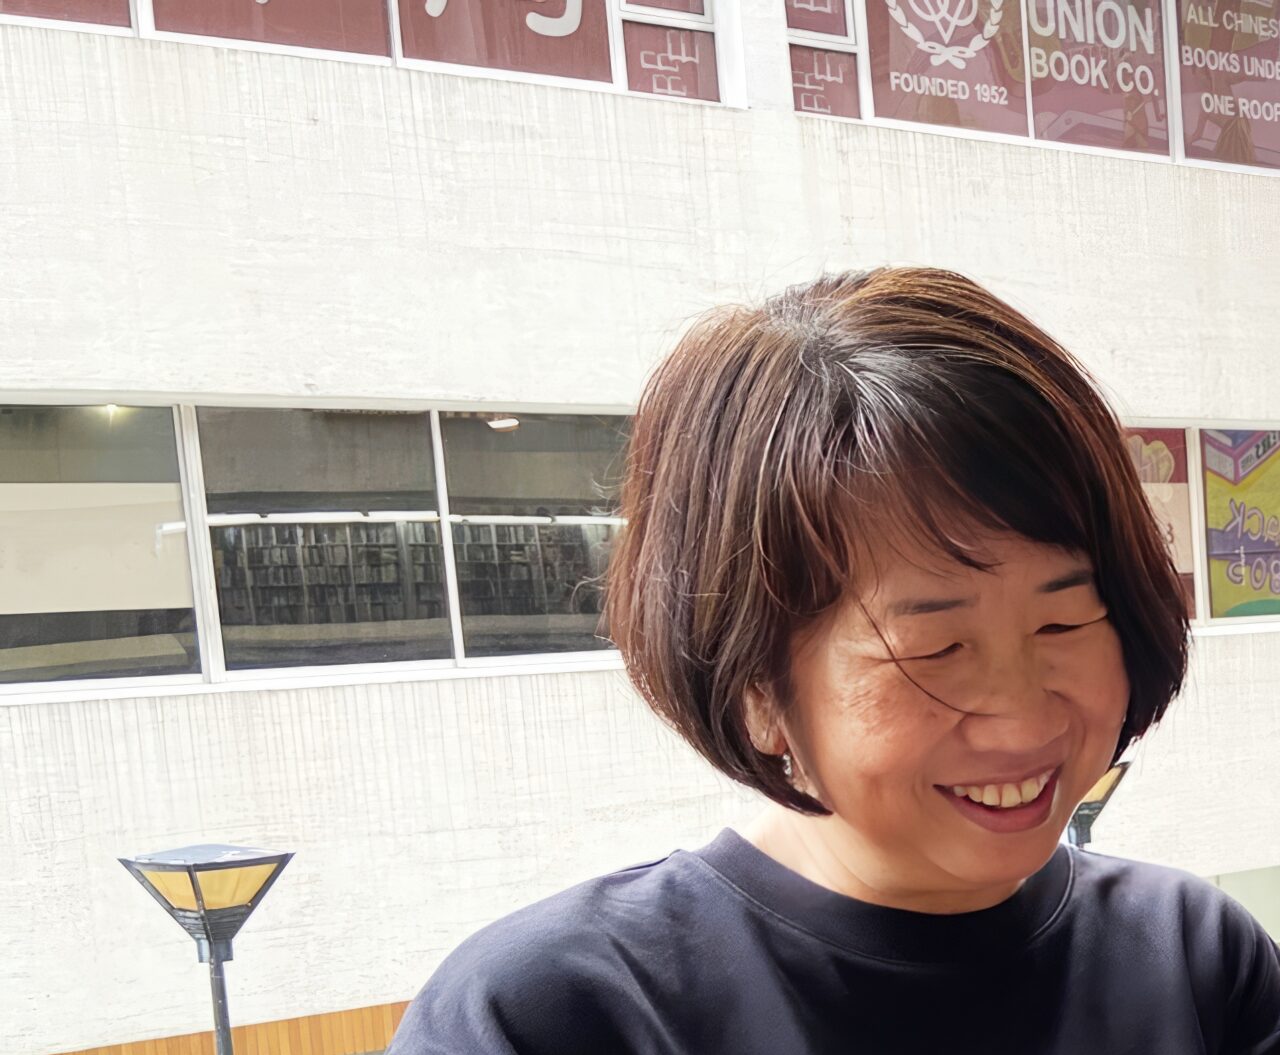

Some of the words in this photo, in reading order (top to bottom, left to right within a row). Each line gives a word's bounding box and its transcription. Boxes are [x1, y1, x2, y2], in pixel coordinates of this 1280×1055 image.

[1028, 0, 1154, 54] UNION
[1186, 4, 1219, 28] ALL
[1031, 47, 1109, 88] BOOK
[1116, 62, 1158, 96] CO.
[1182, 45, 1240, 74] BOOKS
[890, 71, 969, 100] FOUNDED
[974, 83, 1008, 105] 1952
[1201, 92, 1235, 116] ONE
